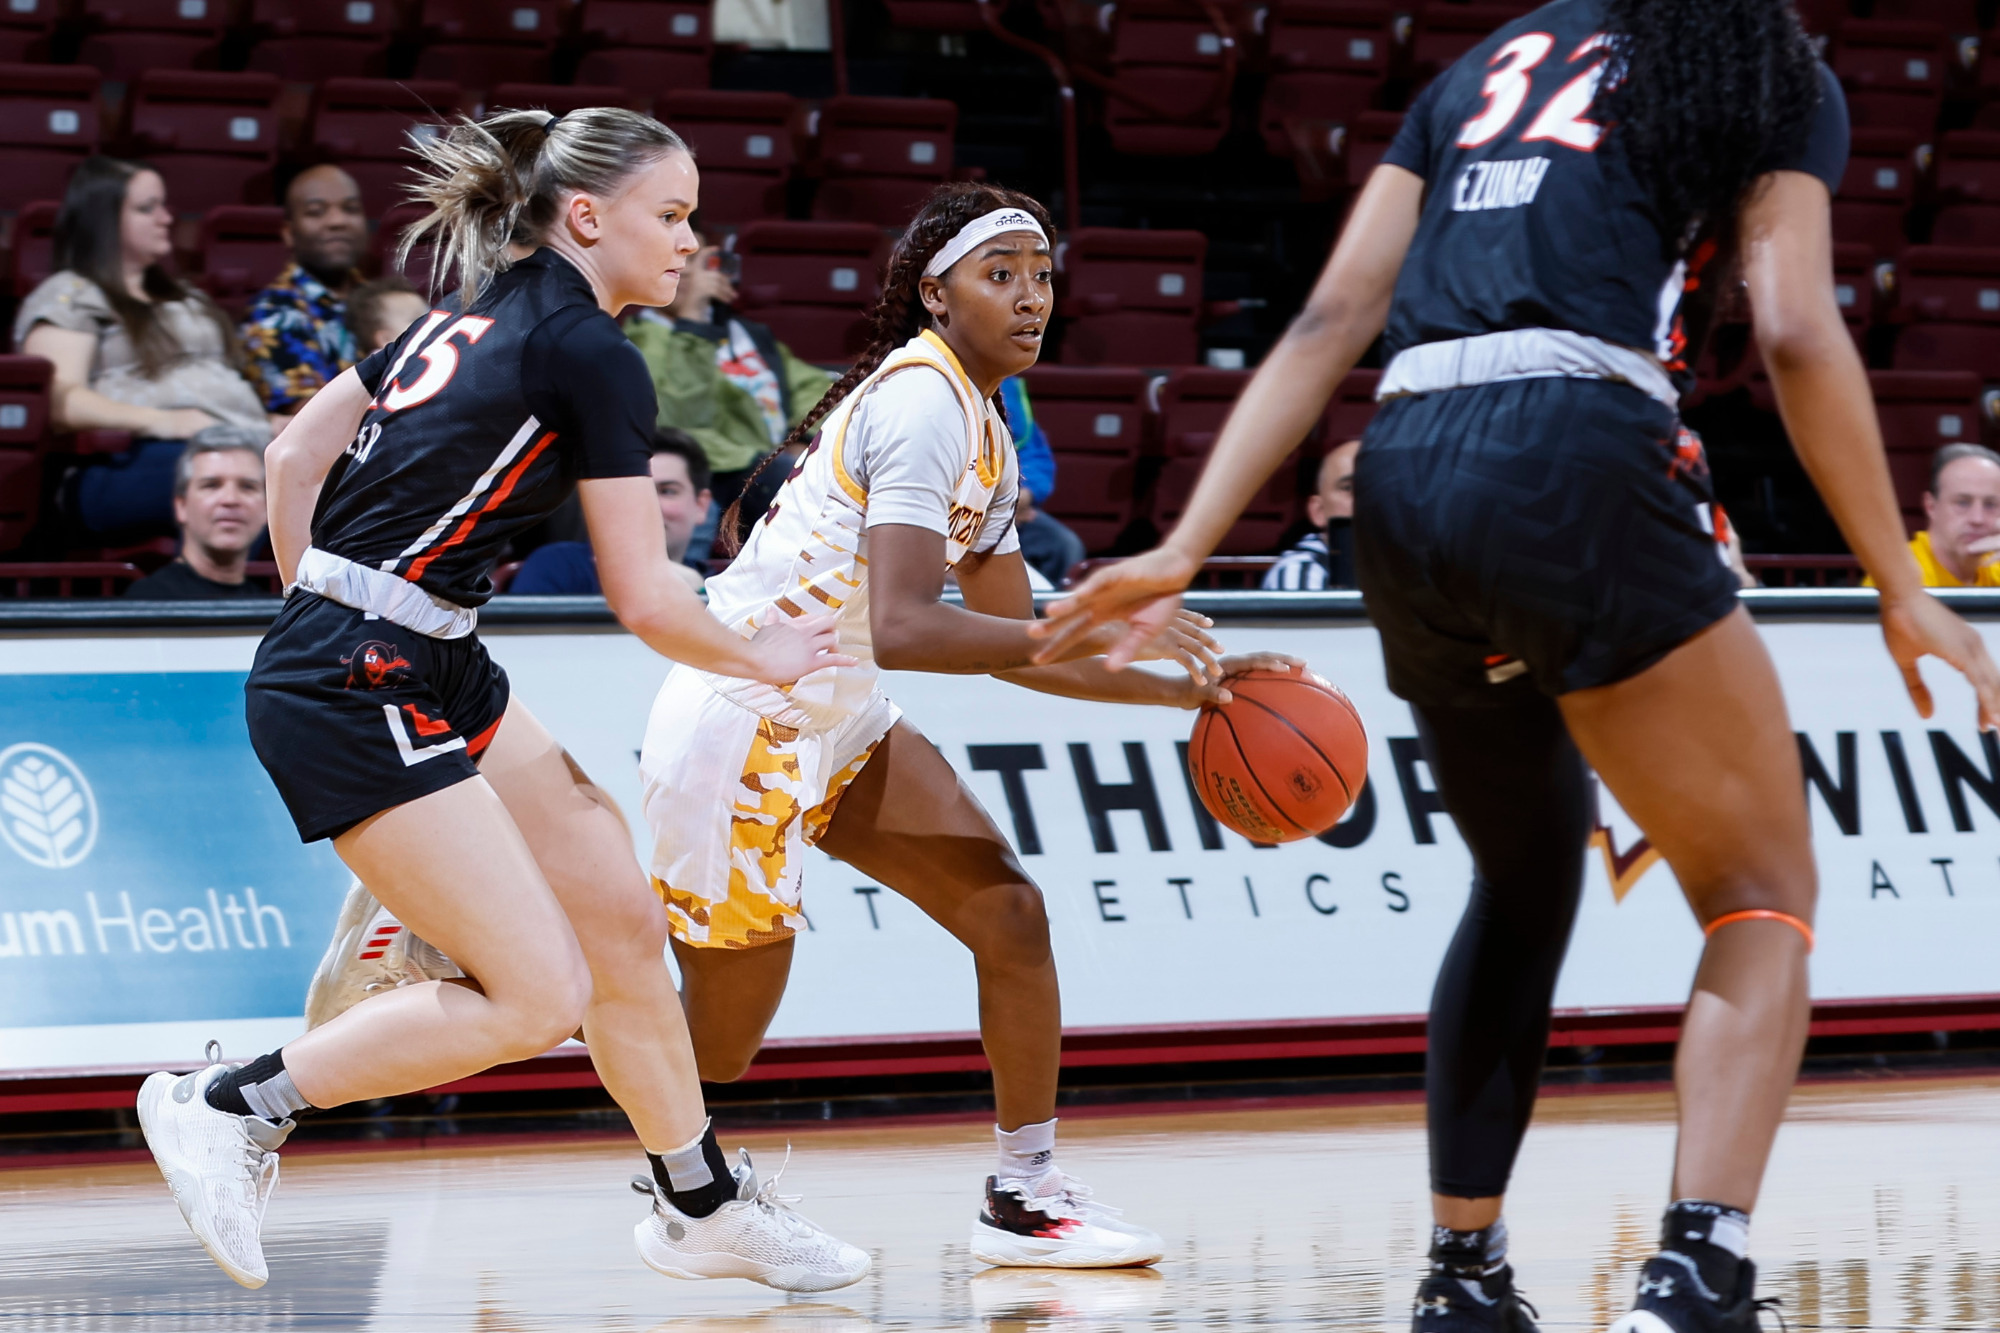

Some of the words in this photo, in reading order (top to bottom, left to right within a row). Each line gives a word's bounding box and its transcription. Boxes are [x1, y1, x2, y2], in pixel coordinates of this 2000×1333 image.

[1456, 30, 1632, 152] 32
[996, 217, 1033, 226] adidas
[368, 310, 496, 413] 15
[1871, 857, 2000, 900] AT
[86, 887, 291, 953] Health
